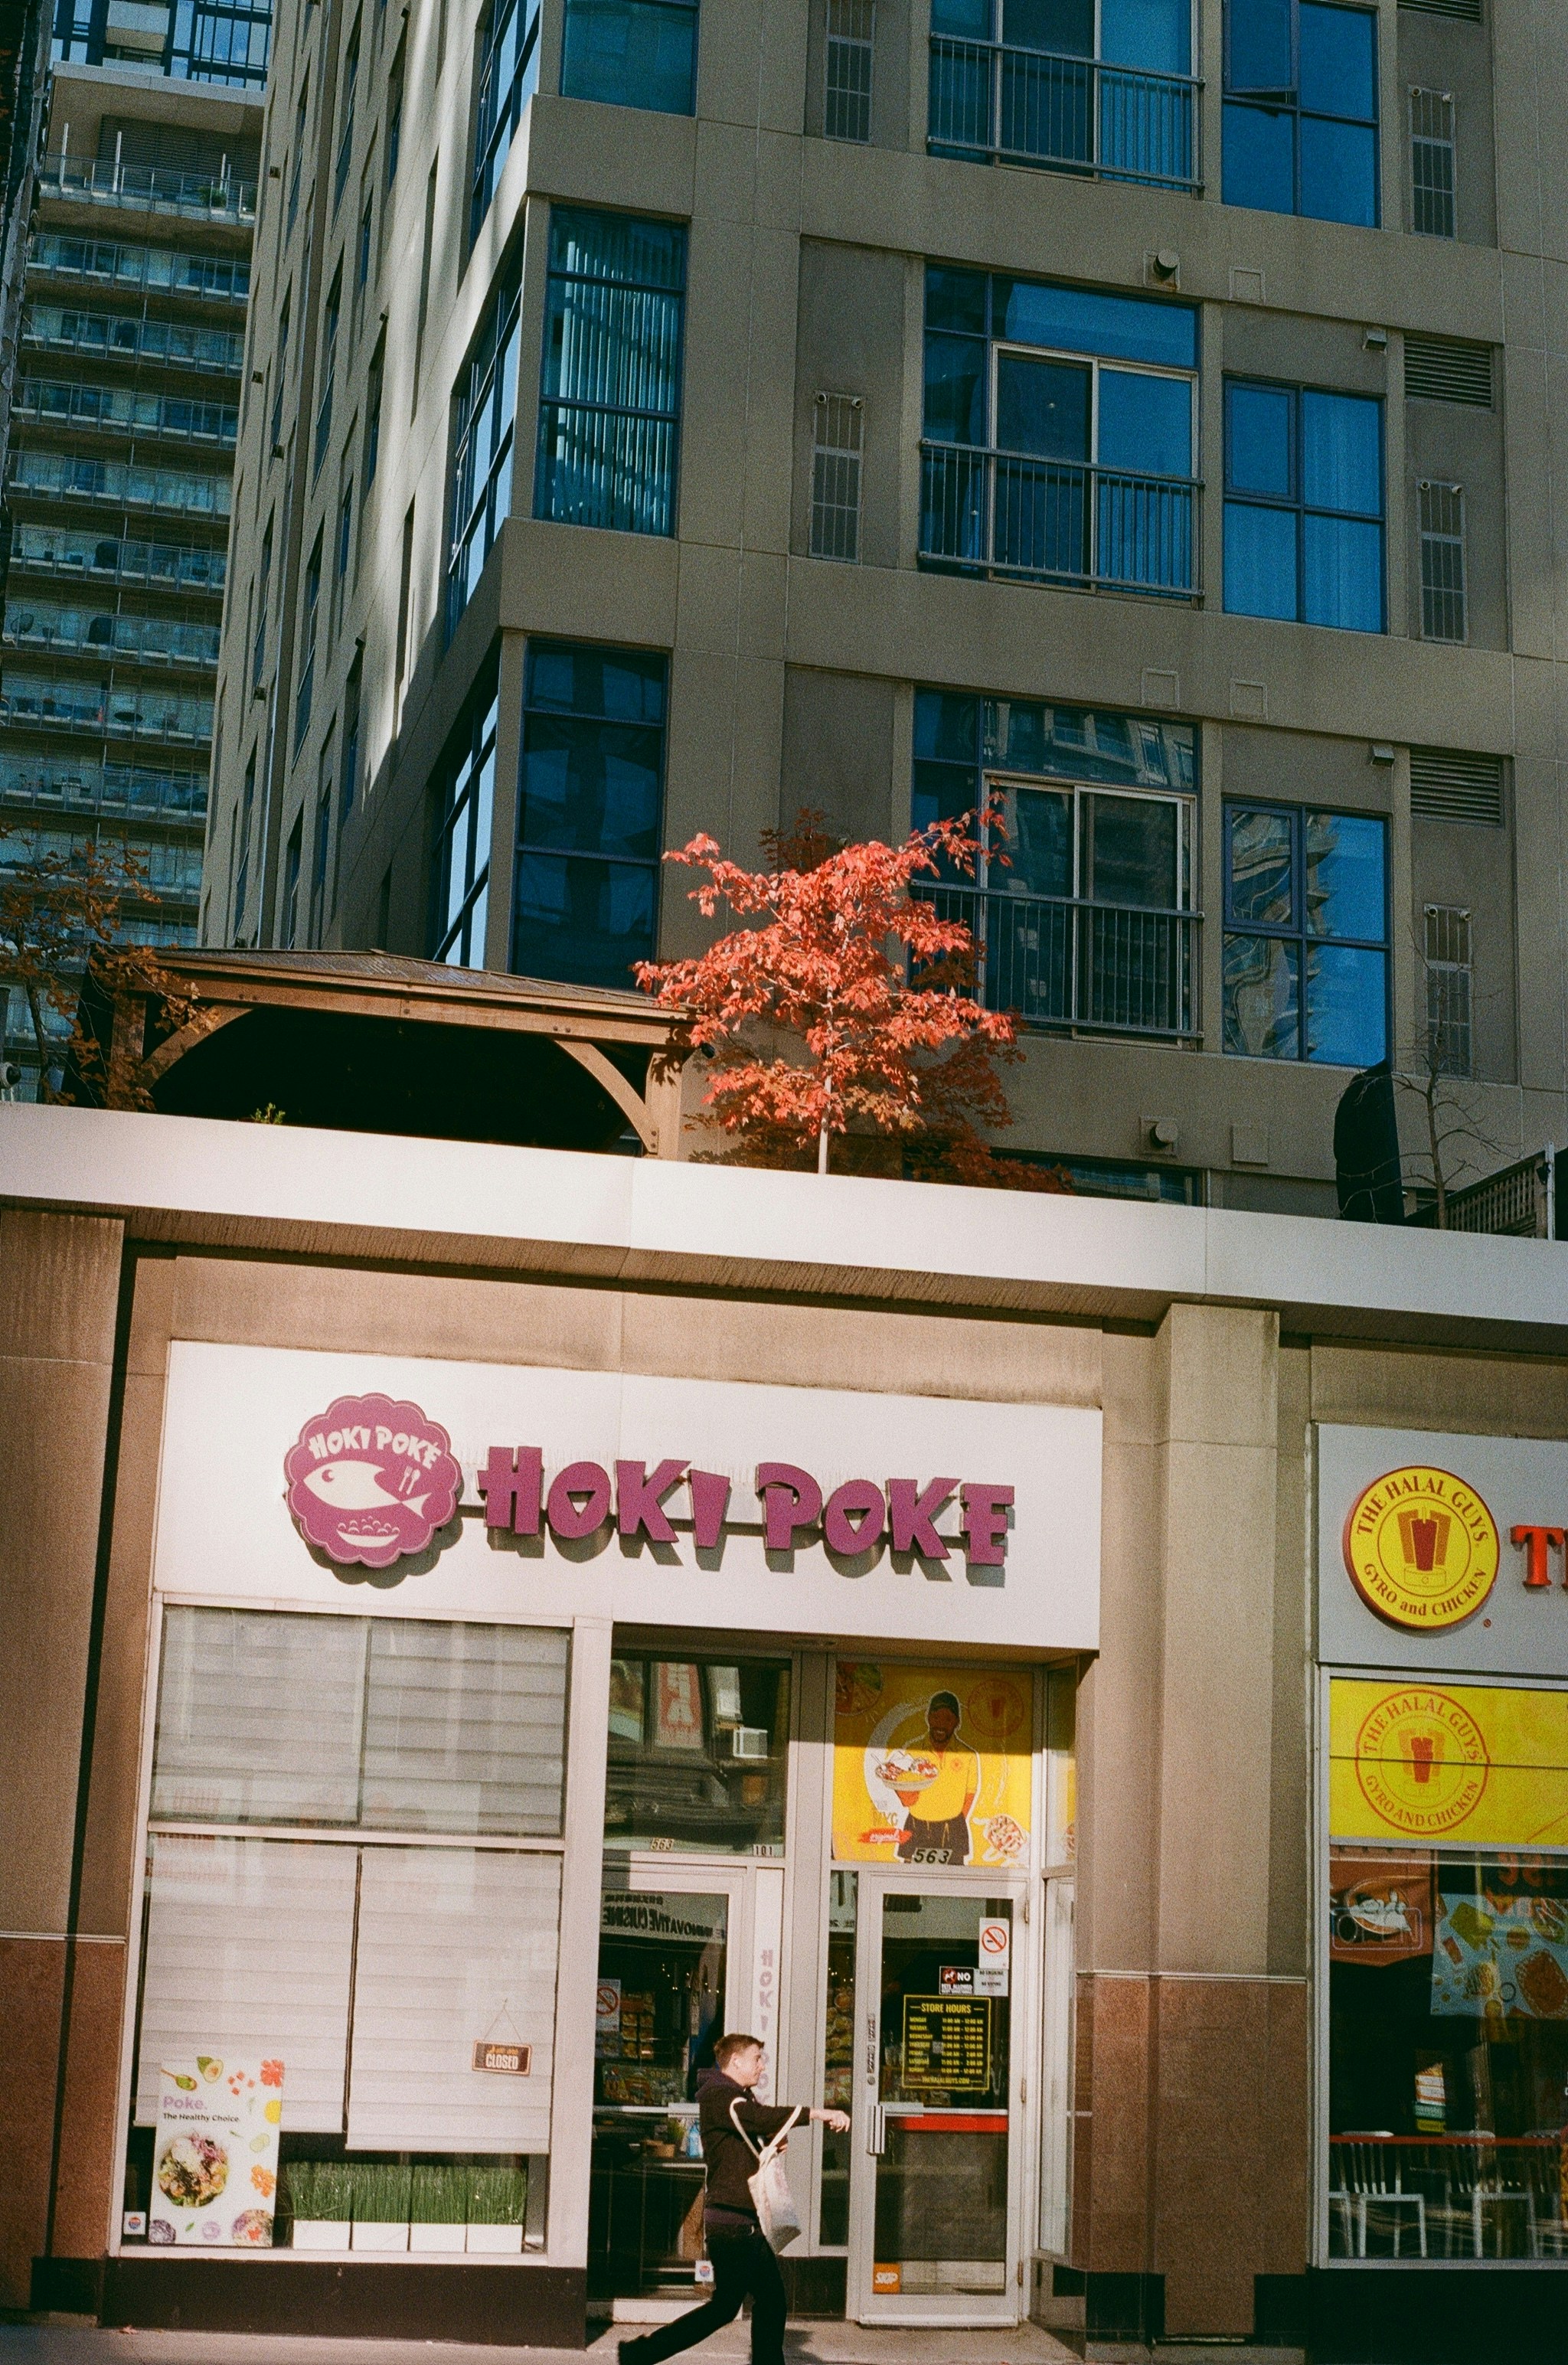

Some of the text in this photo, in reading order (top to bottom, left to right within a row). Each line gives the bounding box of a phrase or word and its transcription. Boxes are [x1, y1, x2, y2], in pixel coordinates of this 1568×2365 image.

[309, 1426, 371, 1459] HOKI
[476, 1445, 1016, 1566] HOKI POKE
[1357, 1475, 1488, 1543] THE HALAL GUYS
[1510, 1524, 1568, 1589] T
[1364, 1563, 1487, 1616] GYRO and CHICKEN
[1363, 1697, 1479, 1761] THE HALAL GUYS
[1365, 1775, 1479, 1827] GYRO AND CHICKEN
[651, 1838, 674, 1851] 563
[755, 1845, 773, 1857] 101
[913, 1848, 951, 1864] 563
[957, 1971, 972, 1982] NO
[921, 2003, 972, 2014] STORE HOURS
[485, 2053, 519, 2070] CLOSED
[163, 2096, 207, 2109] Poke.
[179, 2113, 210, 2122] Healthy
